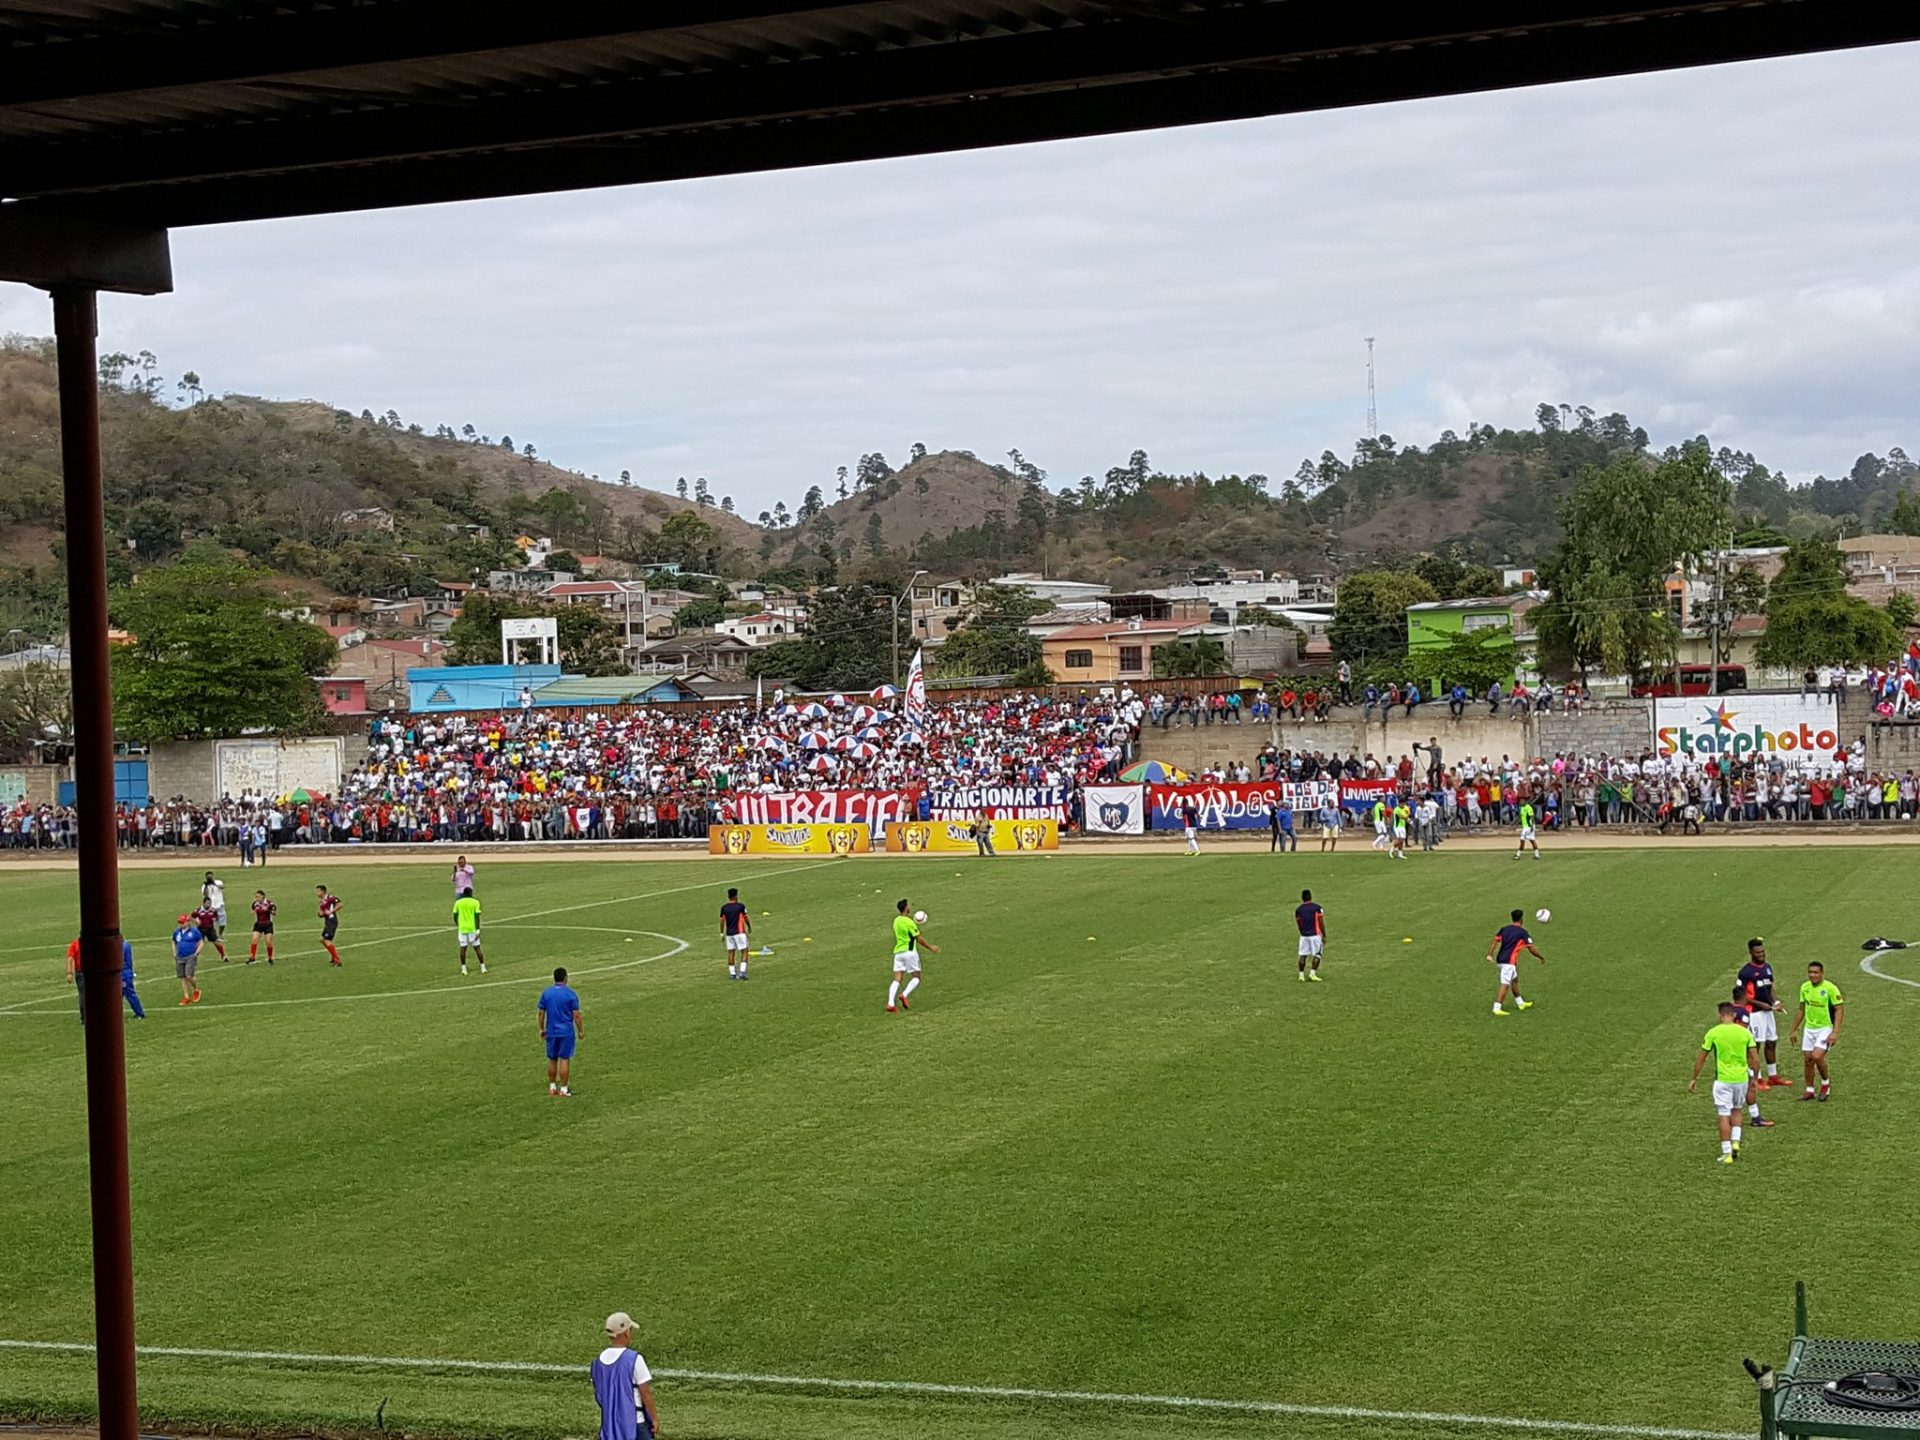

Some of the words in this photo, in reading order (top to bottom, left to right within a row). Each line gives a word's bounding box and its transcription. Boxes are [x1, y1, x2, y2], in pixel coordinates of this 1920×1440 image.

[1657, 723, 1837, 758] Starphoto
[932, 785, 1066, 808] TRAICIONARTE
[1286, 782, 1312, 797] LOS
[994, 804, 1067, 825] OLIMPIA
